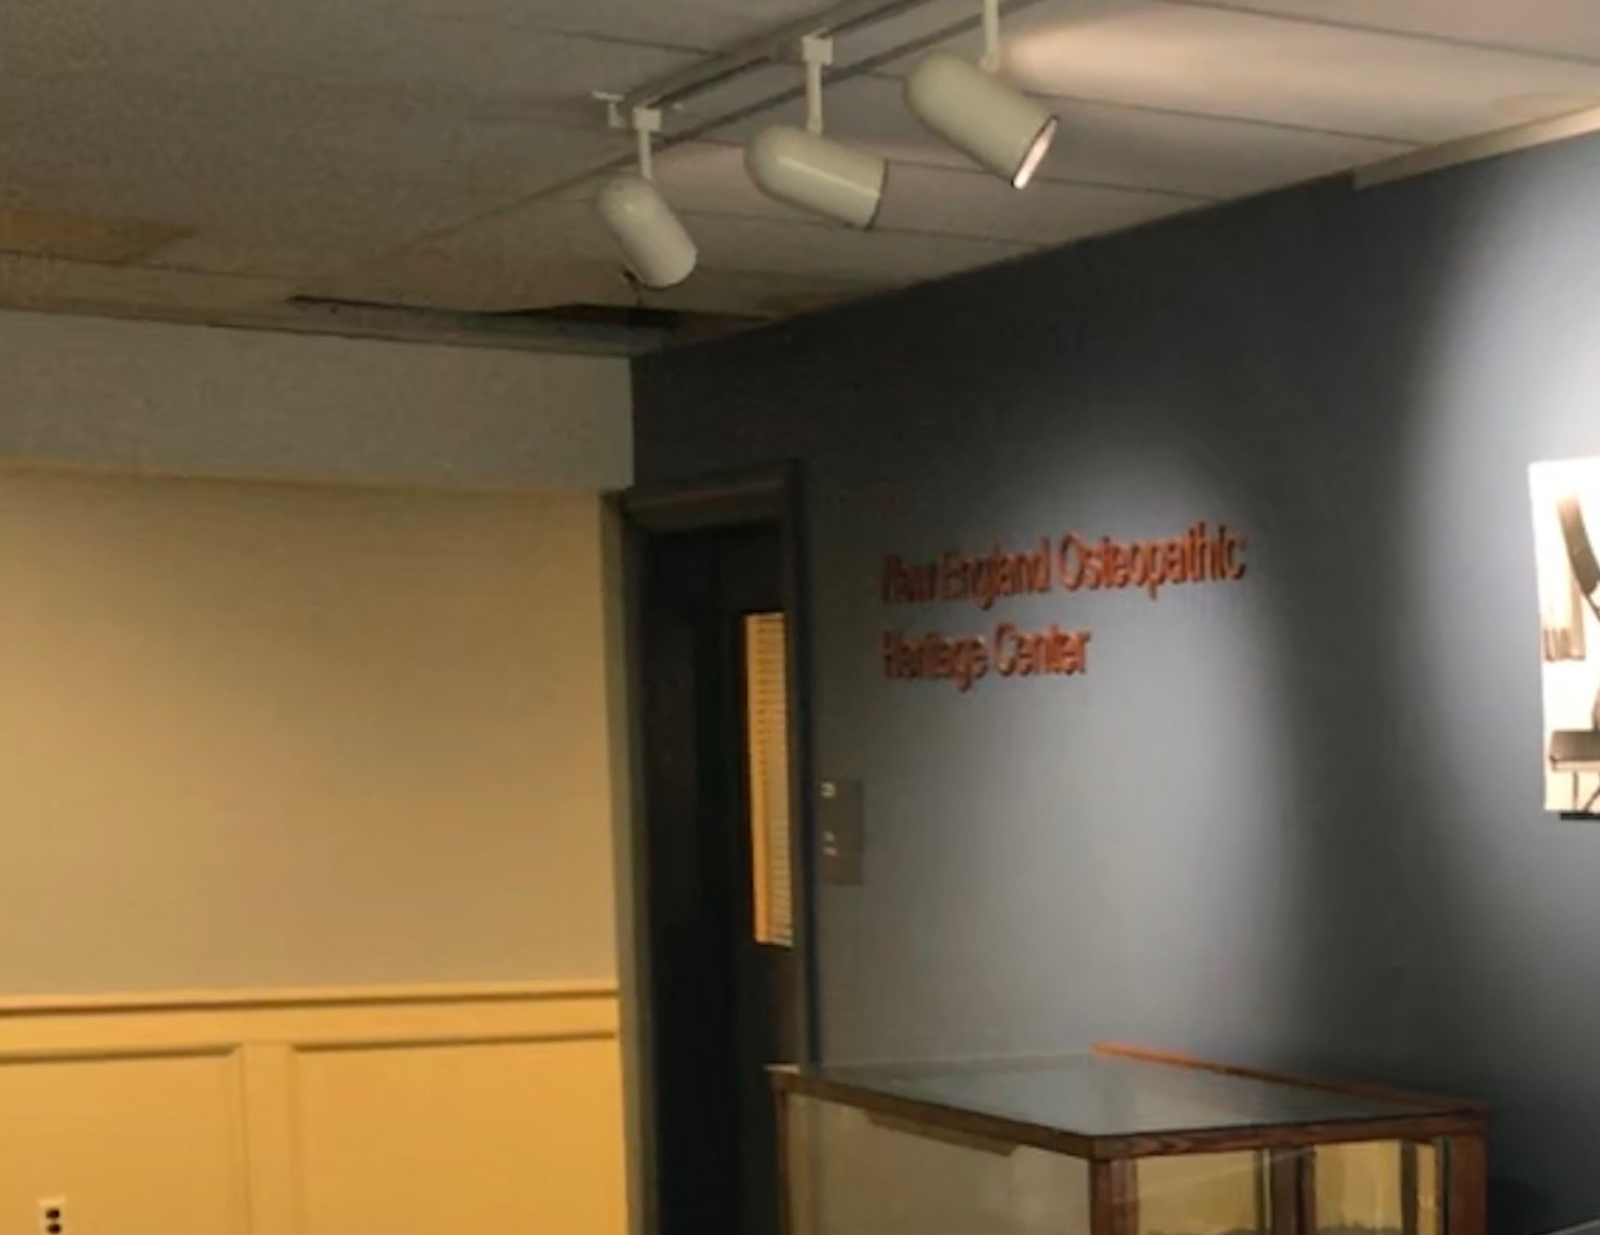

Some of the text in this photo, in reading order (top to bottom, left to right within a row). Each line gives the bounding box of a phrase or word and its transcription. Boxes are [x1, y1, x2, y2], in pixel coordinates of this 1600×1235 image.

[883, 520, 1248, 612] New England Osteopathic
[884, 621, 1091, 692] Heritage Center
